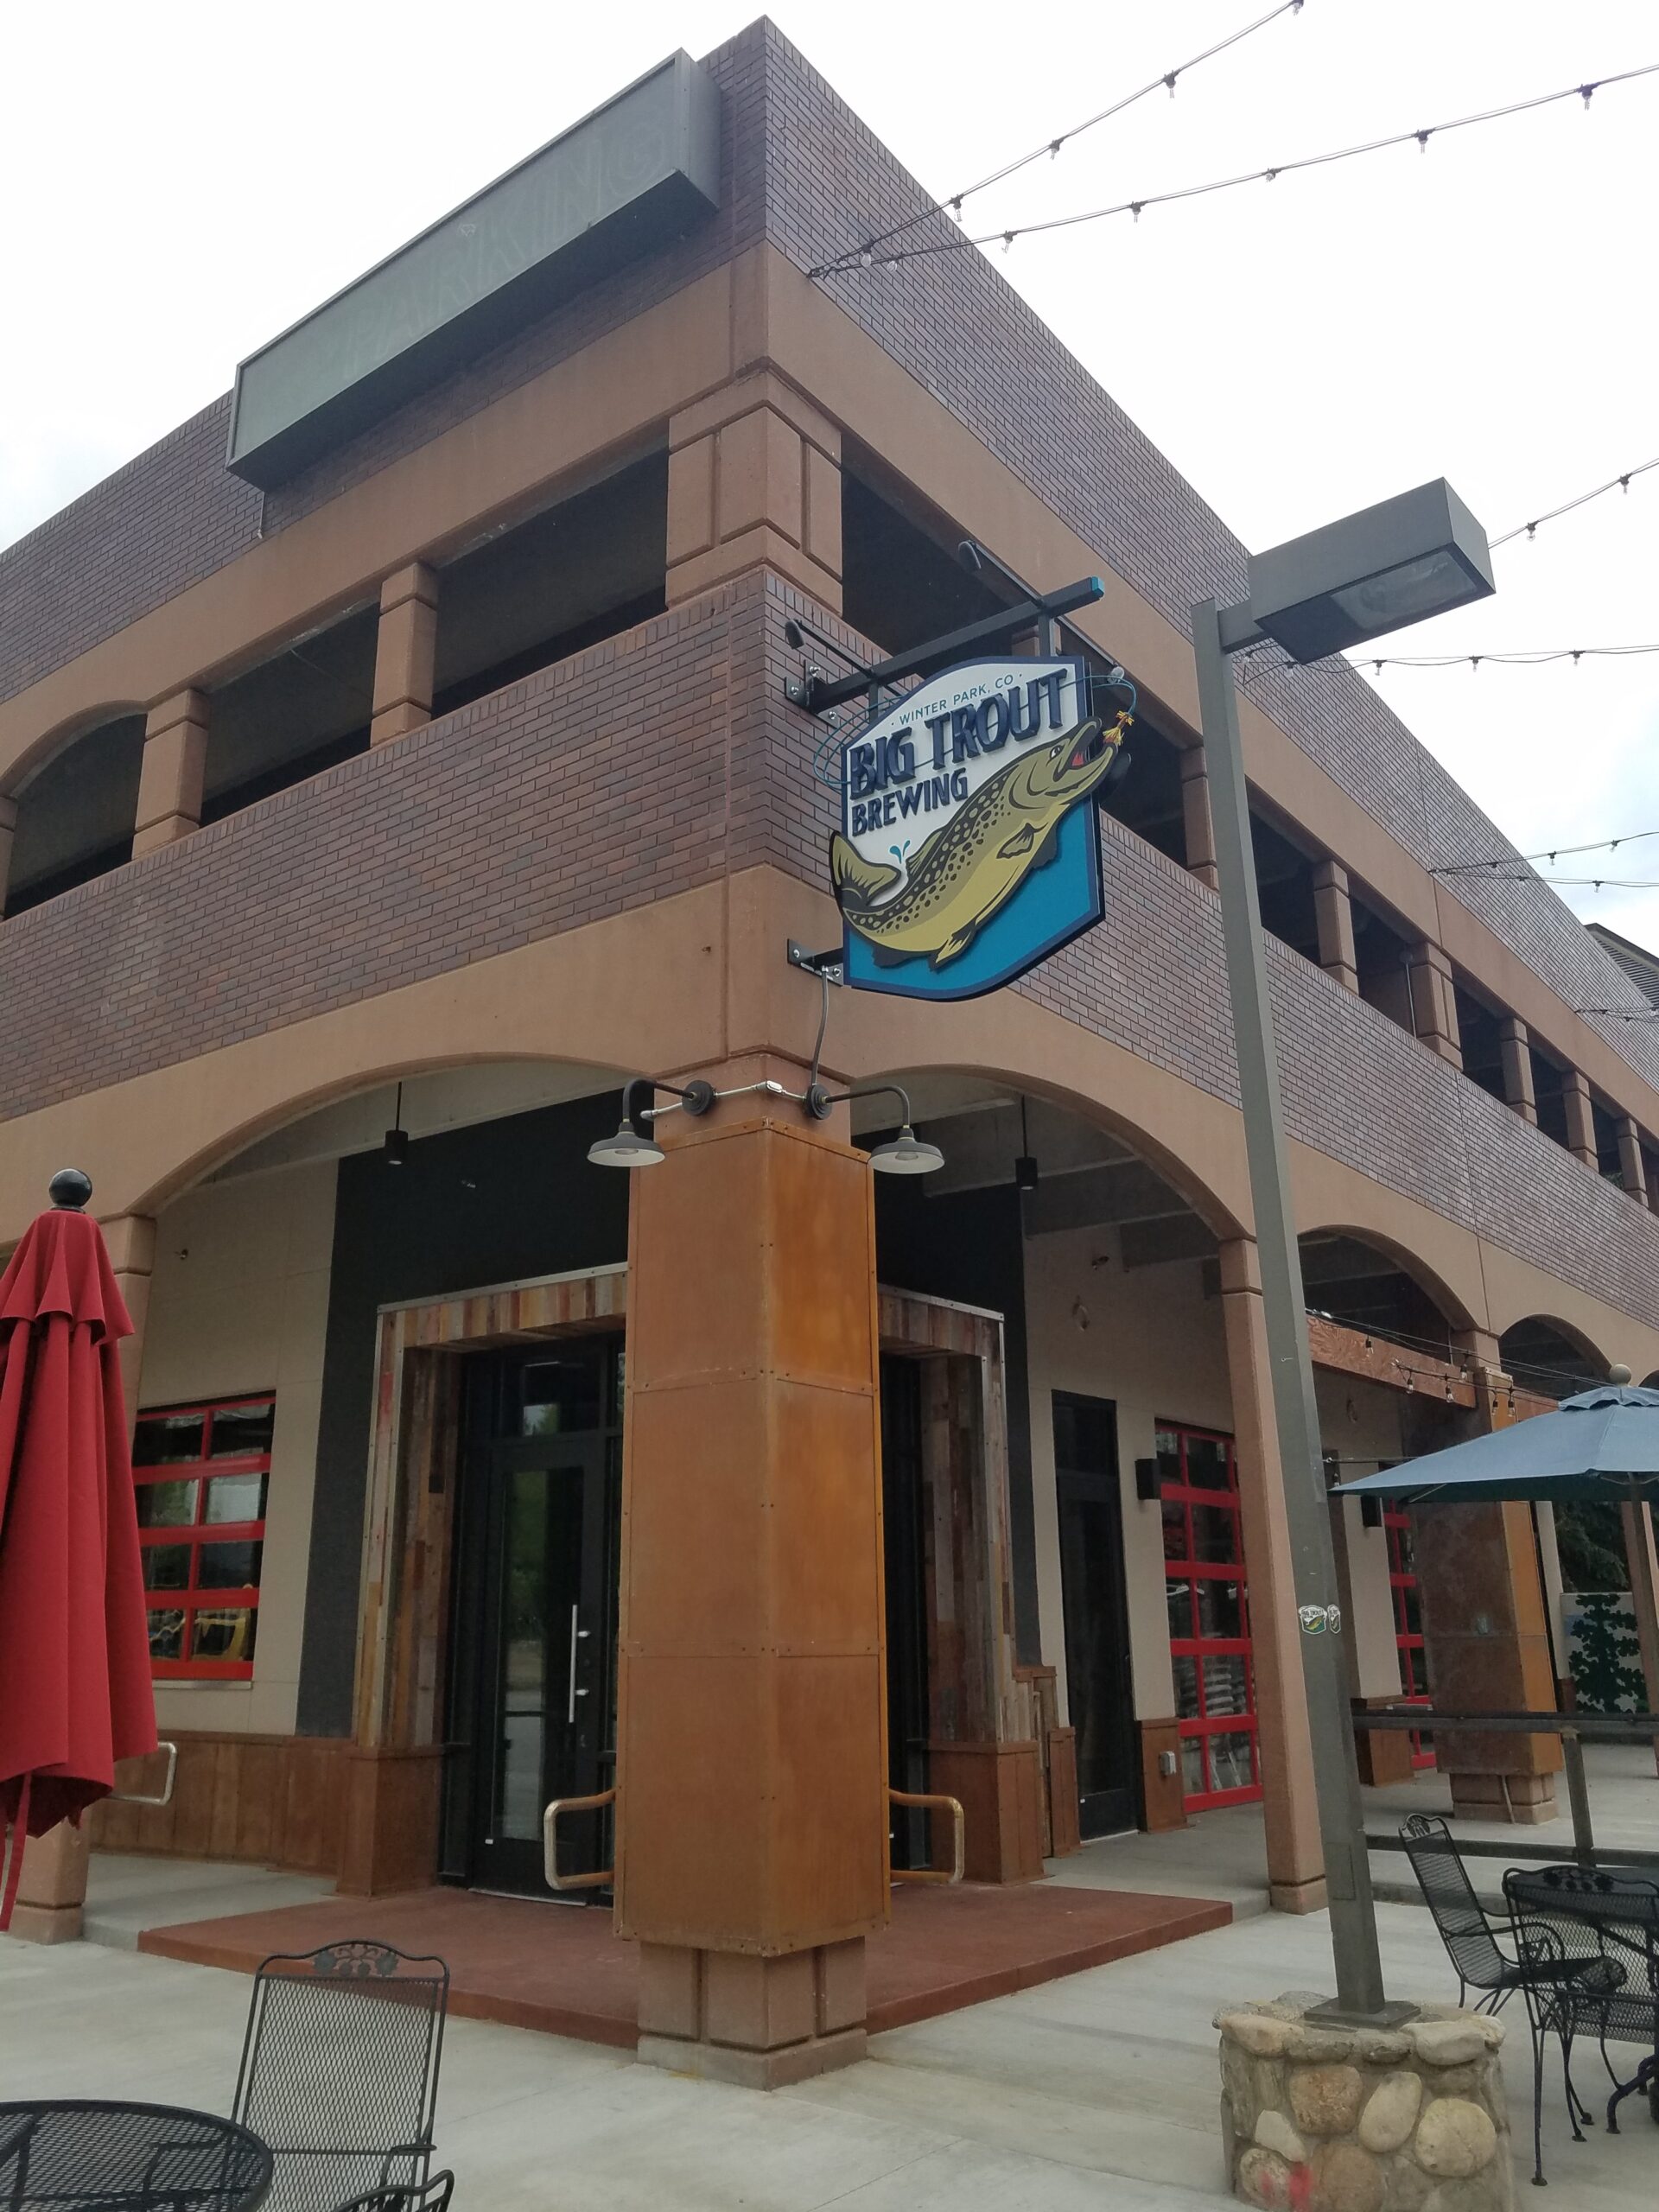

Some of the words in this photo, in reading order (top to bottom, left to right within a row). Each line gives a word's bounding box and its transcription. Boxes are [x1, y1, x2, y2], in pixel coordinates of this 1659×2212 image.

[899, 699, 947, 725] WINTER
[953, 683, 991, 705] PARK,
[995, 673, 1014, 689] CO
[849, 726, 916, 800] BIG
[924, 668, 1068, 770] TROUT
[851, 767, 969, 836] BREWING
